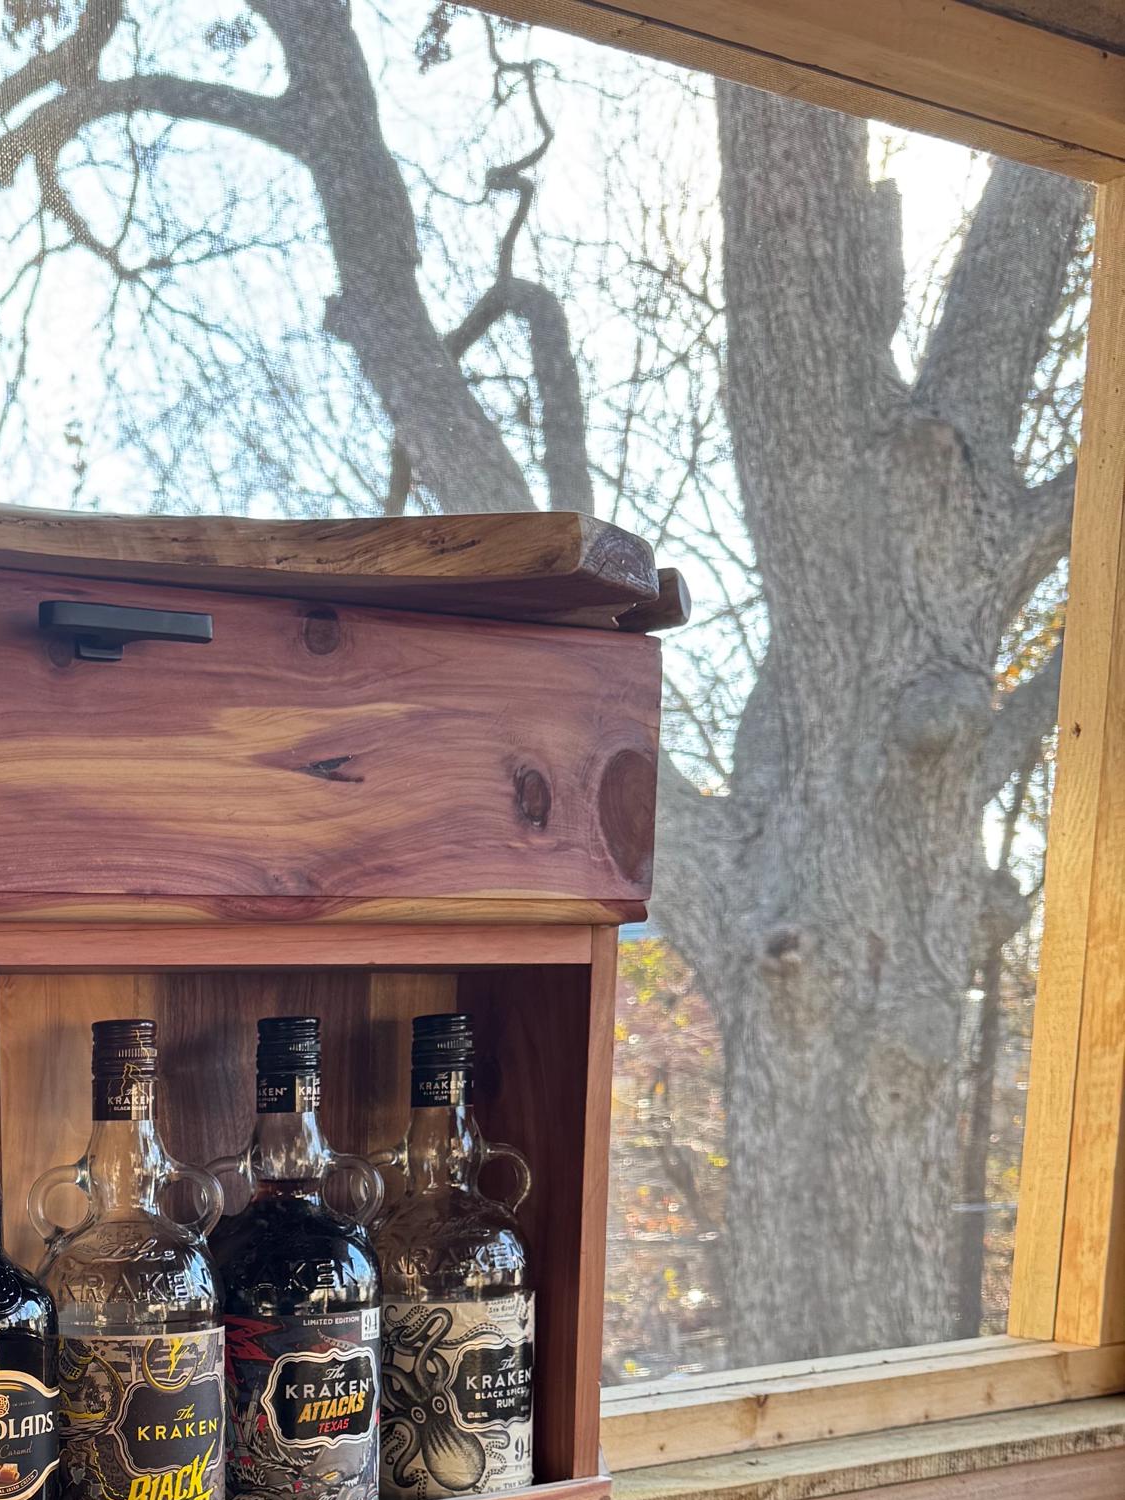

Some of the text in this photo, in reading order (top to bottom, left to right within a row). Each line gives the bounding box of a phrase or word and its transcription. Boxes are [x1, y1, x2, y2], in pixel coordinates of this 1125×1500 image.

[419, 1080, 465, 1090] KRAKEN
[107, 1095, 153, 1105] KRAKEN
[303, 1316, 360, 1327] LIMITED EDITION
[322, 1363, 345, 1380] The
[466, 1366, 532, 1390] KRAKEN
[285, 1378, 370, 1399] KRAKEN
[475, 1391, 504, 1400] BLACK
[298, 1391, 366, 1424] ATTACKS
[496, 1398, 515, 1409] RUM
[173, 1403, 195, 1421] The
[137, 1418, 217, 1441] KRAKEN
[318, 1418, 350, 1434] TEXAS
